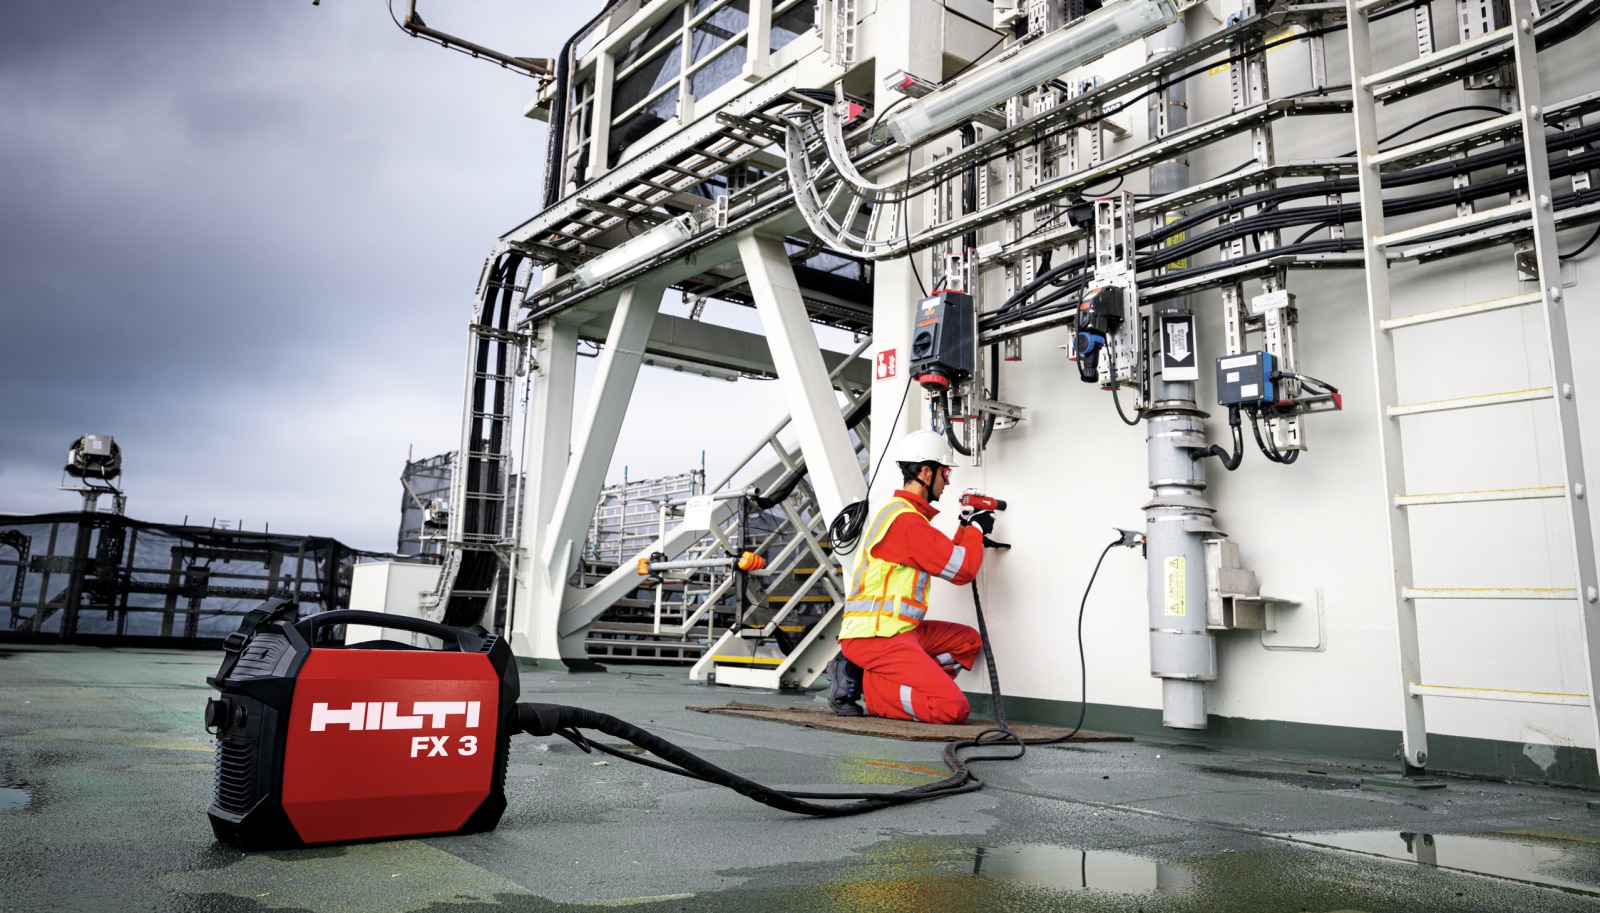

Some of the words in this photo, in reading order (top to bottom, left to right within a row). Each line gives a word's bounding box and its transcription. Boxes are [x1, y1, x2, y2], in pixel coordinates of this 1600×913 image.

[310, 701, 481, 731] HILTI
[410, 736, 449, 758] FX
[457, 735, 478, 756] 3
